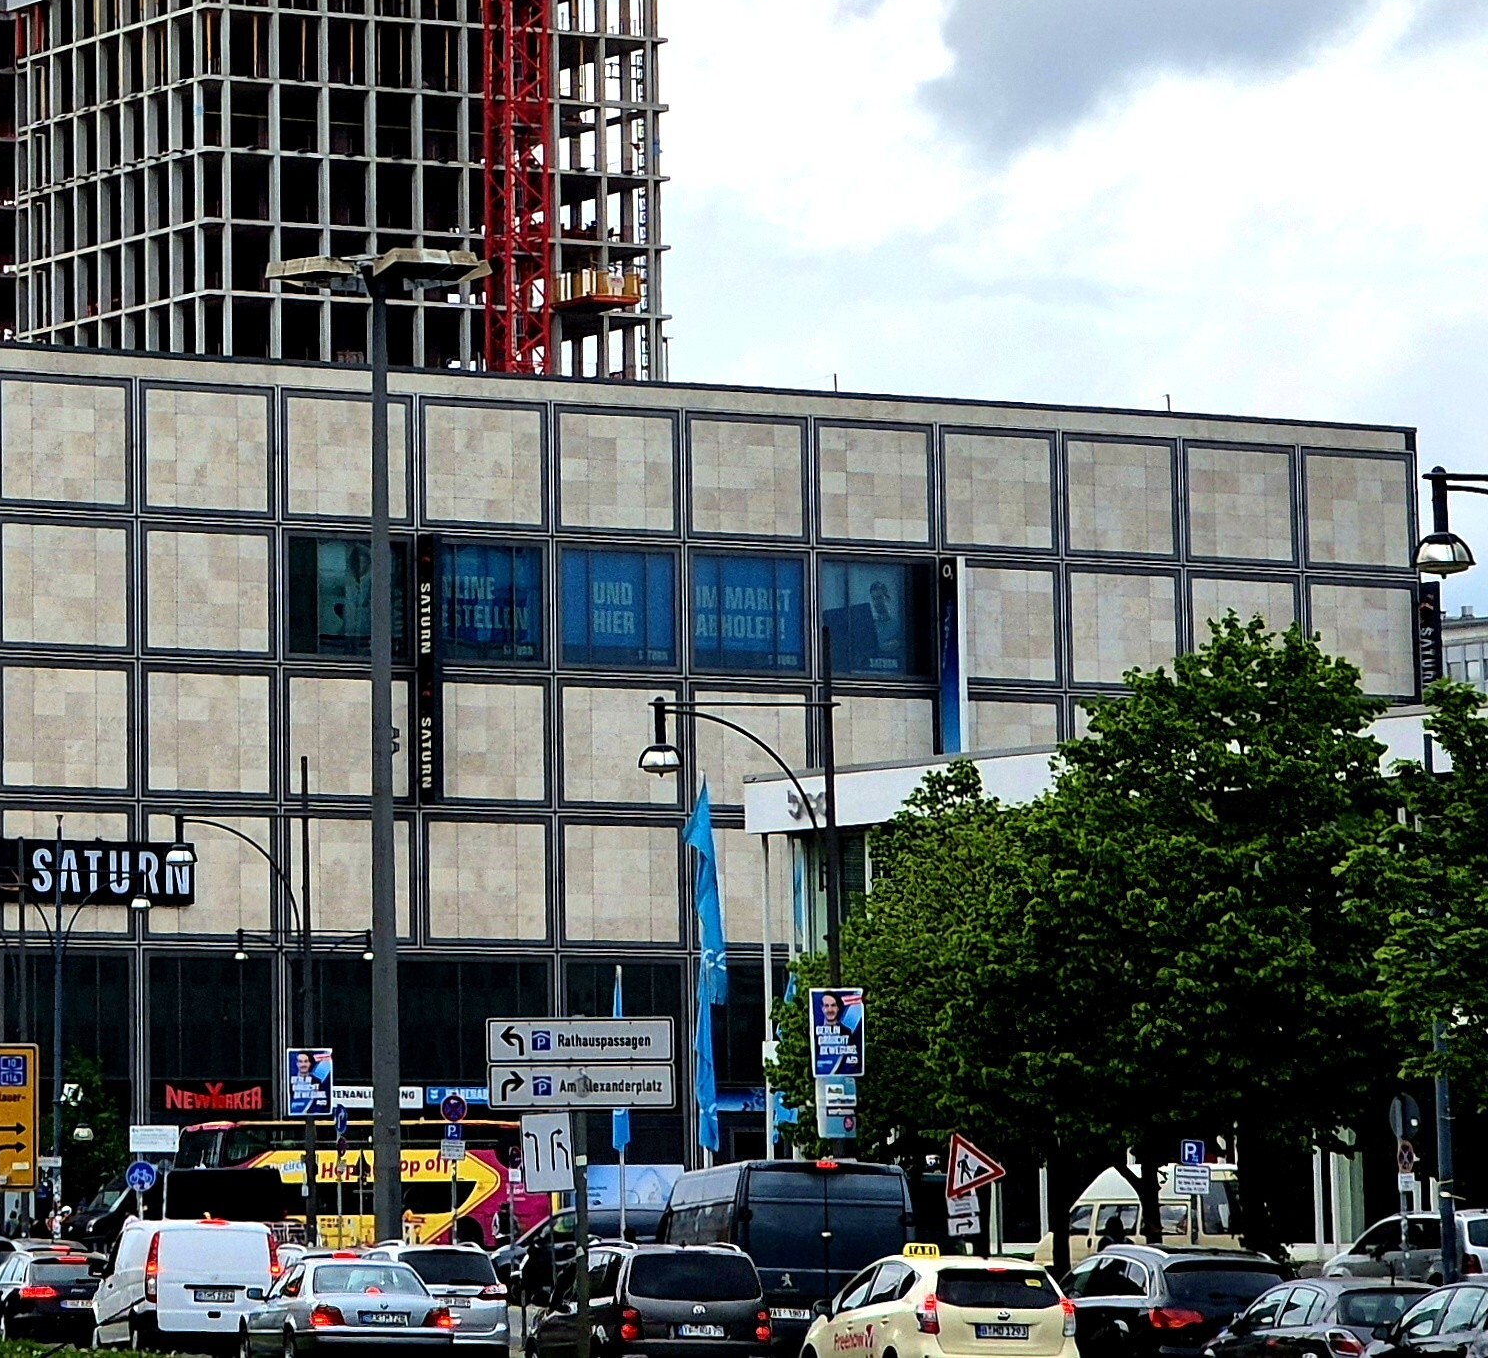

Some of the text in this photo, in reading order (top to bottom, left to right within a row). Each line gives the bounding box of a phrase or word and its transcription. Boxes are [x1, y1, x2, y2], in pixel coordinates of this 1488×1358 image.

[441, 575, 496, 600] NLINE
[593, 581, 633, 606] UND
[695, 585, 718, 609] IM
[420, 582, 431, 655] SATURN
[593, 609, 635, 635] HIER
[421, 717, 432, 790] SATURN
[32, 848, 190, 895] SATURN
[557, 1033, 651, 1051] Rathauspassagen
[7, 1058, 16, 1067] 10
[559, 1079, 577, 1092] Am
[400, 1159, 421, 1178] op
[910, 1245, 937, 1256] TAXI
